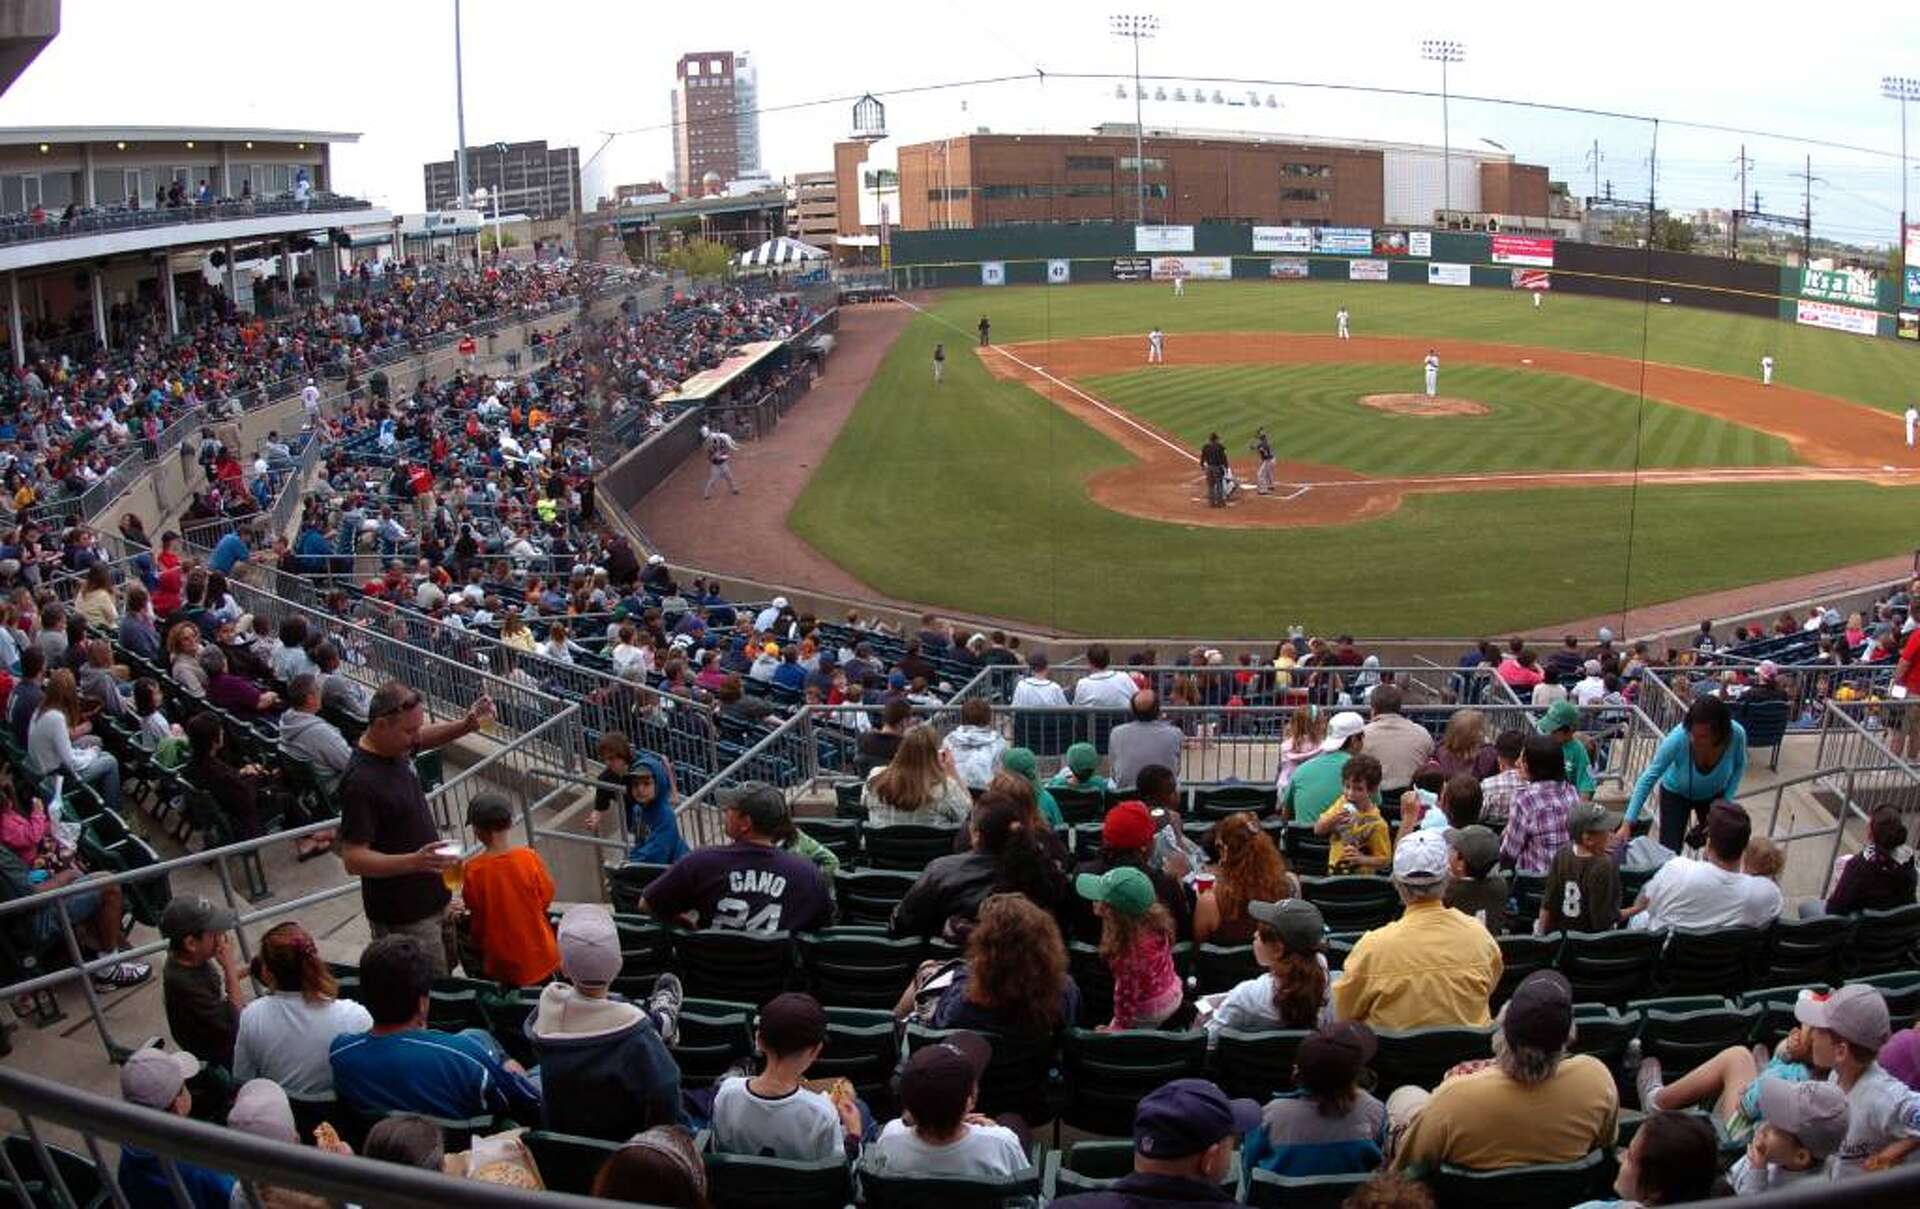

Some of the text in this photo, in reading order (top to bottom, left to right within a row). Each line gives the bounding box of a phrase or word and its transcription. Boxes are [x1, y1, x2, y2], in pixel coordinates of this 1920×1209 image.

[729, 869, 787, 898] CANO
[1562, 880, 1581, 918] 8
[711, 897, 783, 935] 24
